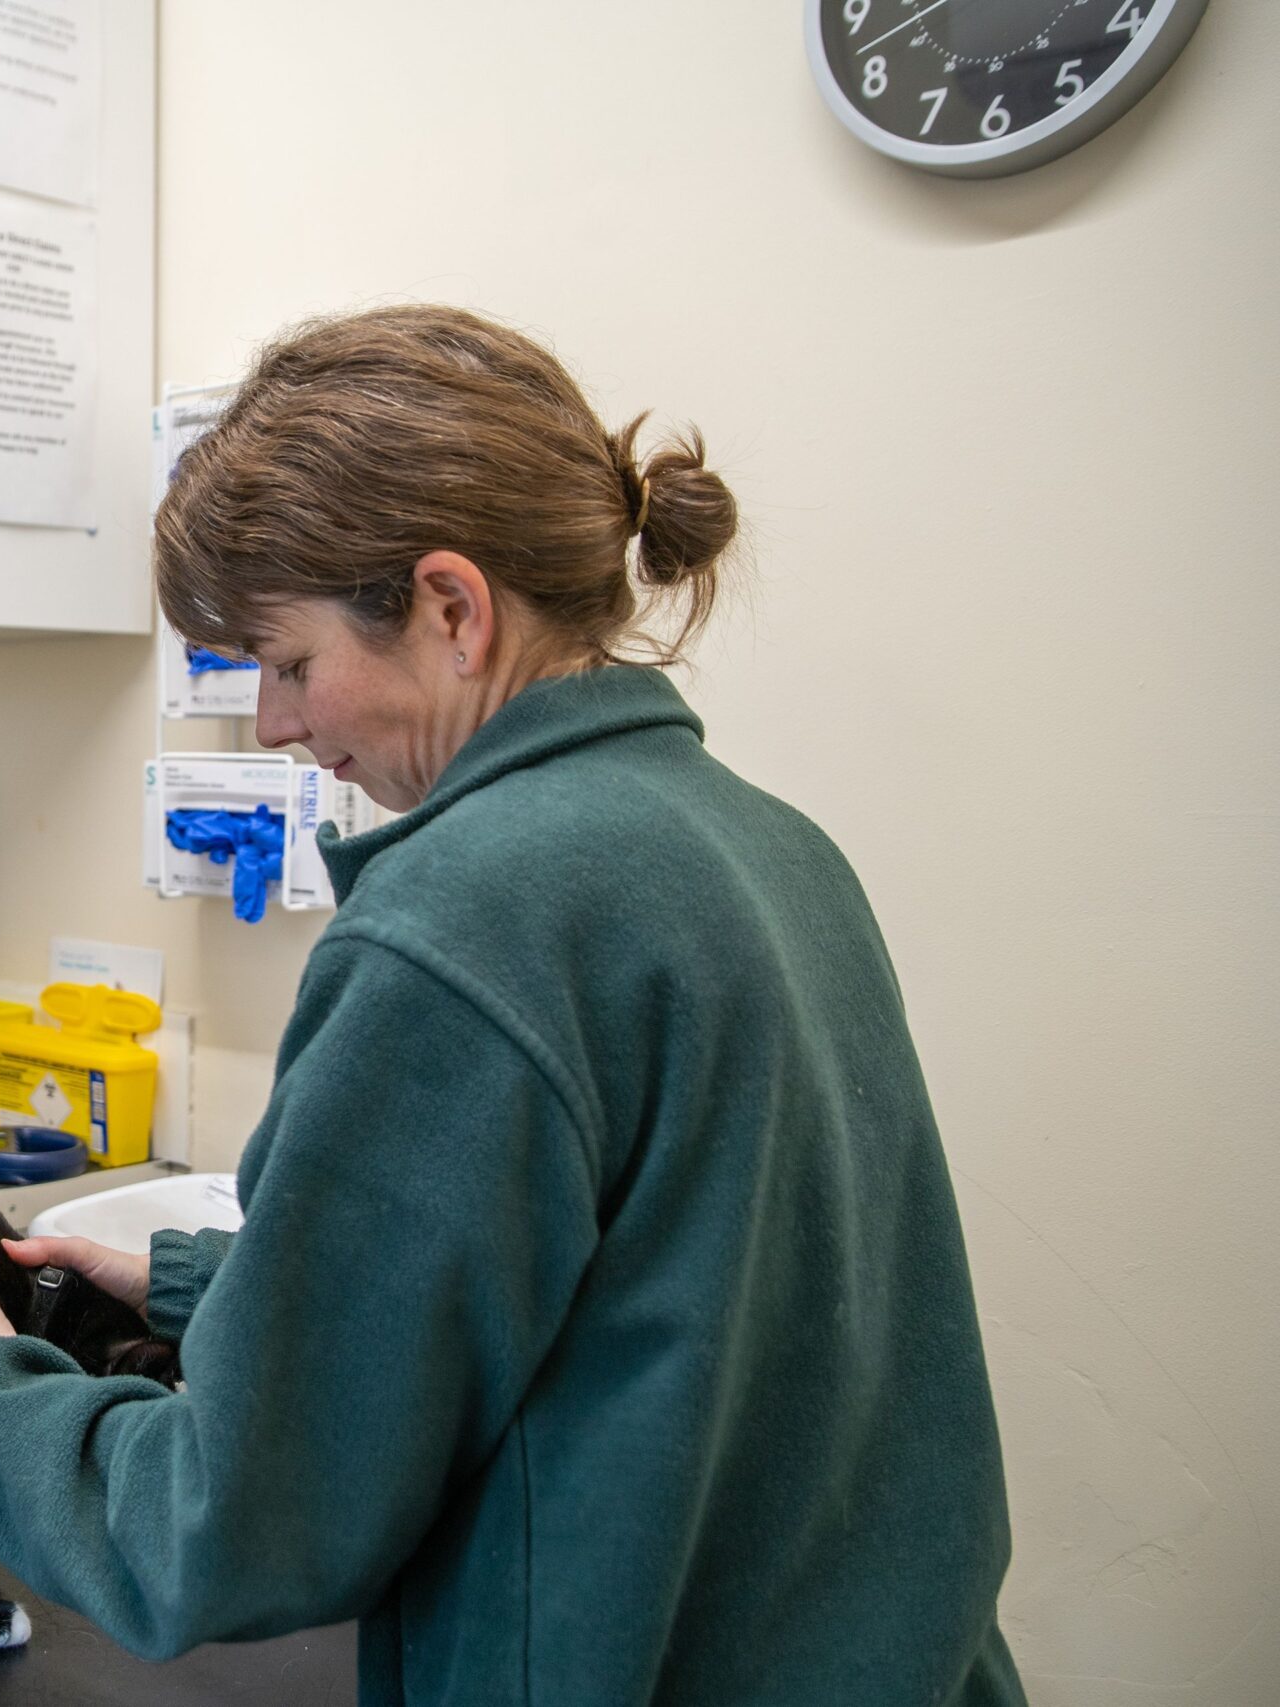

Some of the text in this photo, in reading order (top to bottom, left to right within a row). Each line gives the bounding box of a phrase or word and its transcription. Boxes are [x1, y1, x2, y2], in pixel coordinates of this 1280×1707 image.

[843, 0, 871, 36] 9
[1105, 0, 1145, 39] 4
[862, 55, 888, 99] 8
[1054, 58, 1084, 106] 5
[919, 87, 948, 136] 7
[980, 94, 1011, 139] 6
[146, 766, 157, 785] S
[304, 771, 318, 829] NITRILE
